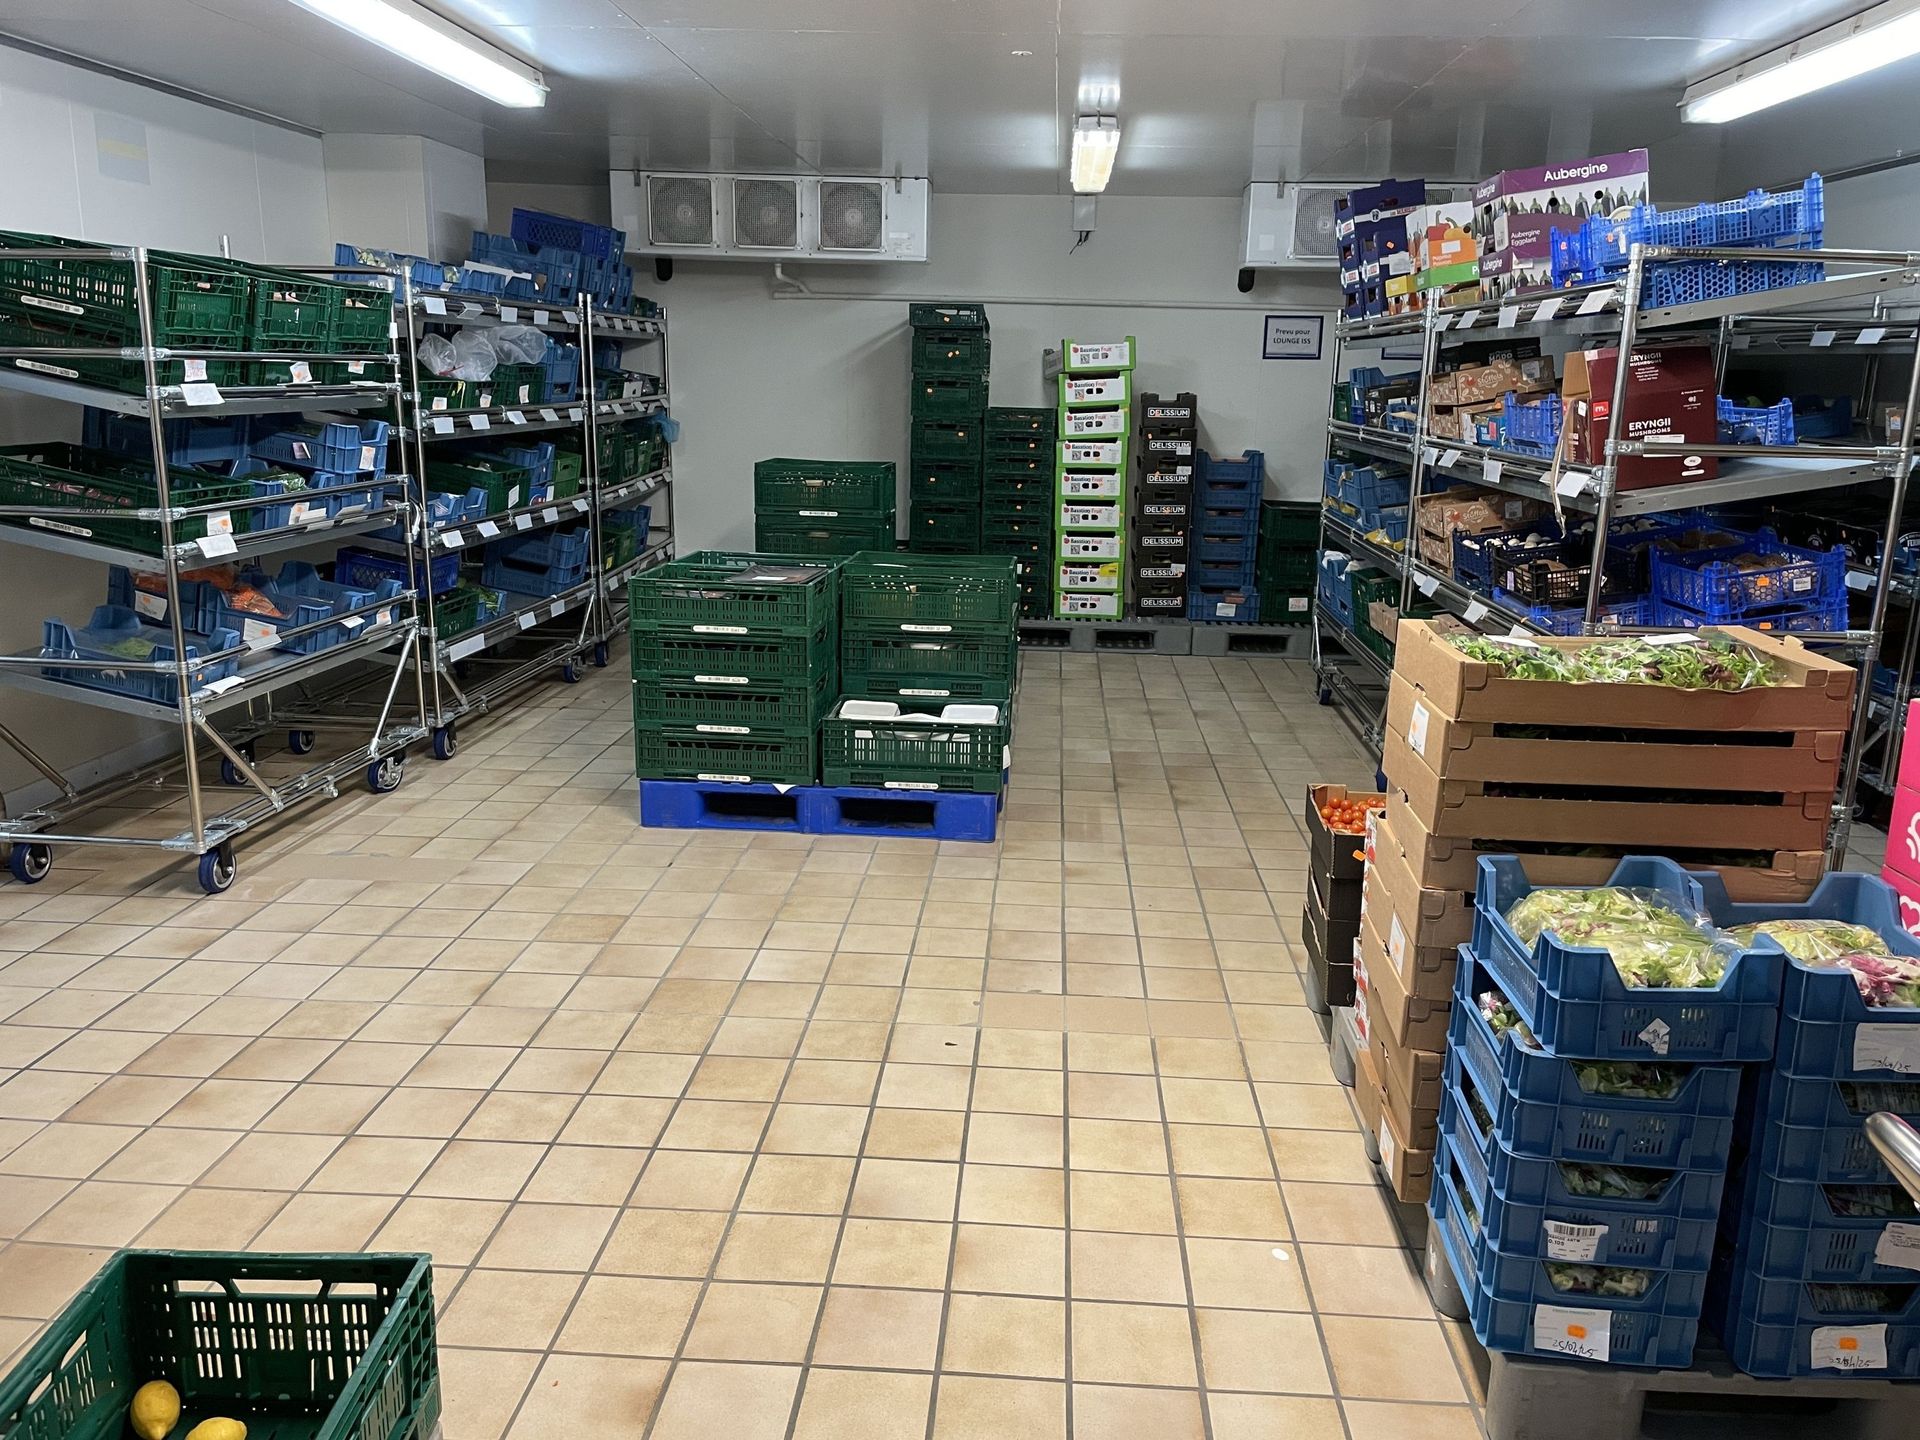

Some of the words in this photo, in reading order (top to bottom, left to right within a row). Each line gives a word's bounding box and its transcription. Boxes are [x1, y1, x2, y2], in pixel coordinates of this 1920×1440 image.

[1544, 163, 1608, 182] Aubergine
[1511, 229, 1541, 240] Aubergine
[1511, 237, 1537, 247] Eggplant
[1301, 337, 1311, 345] ISS
[1629, 418, 1671, 431] ERYNGII
[1629, 427, 1671, 437] MUSHROOMS
